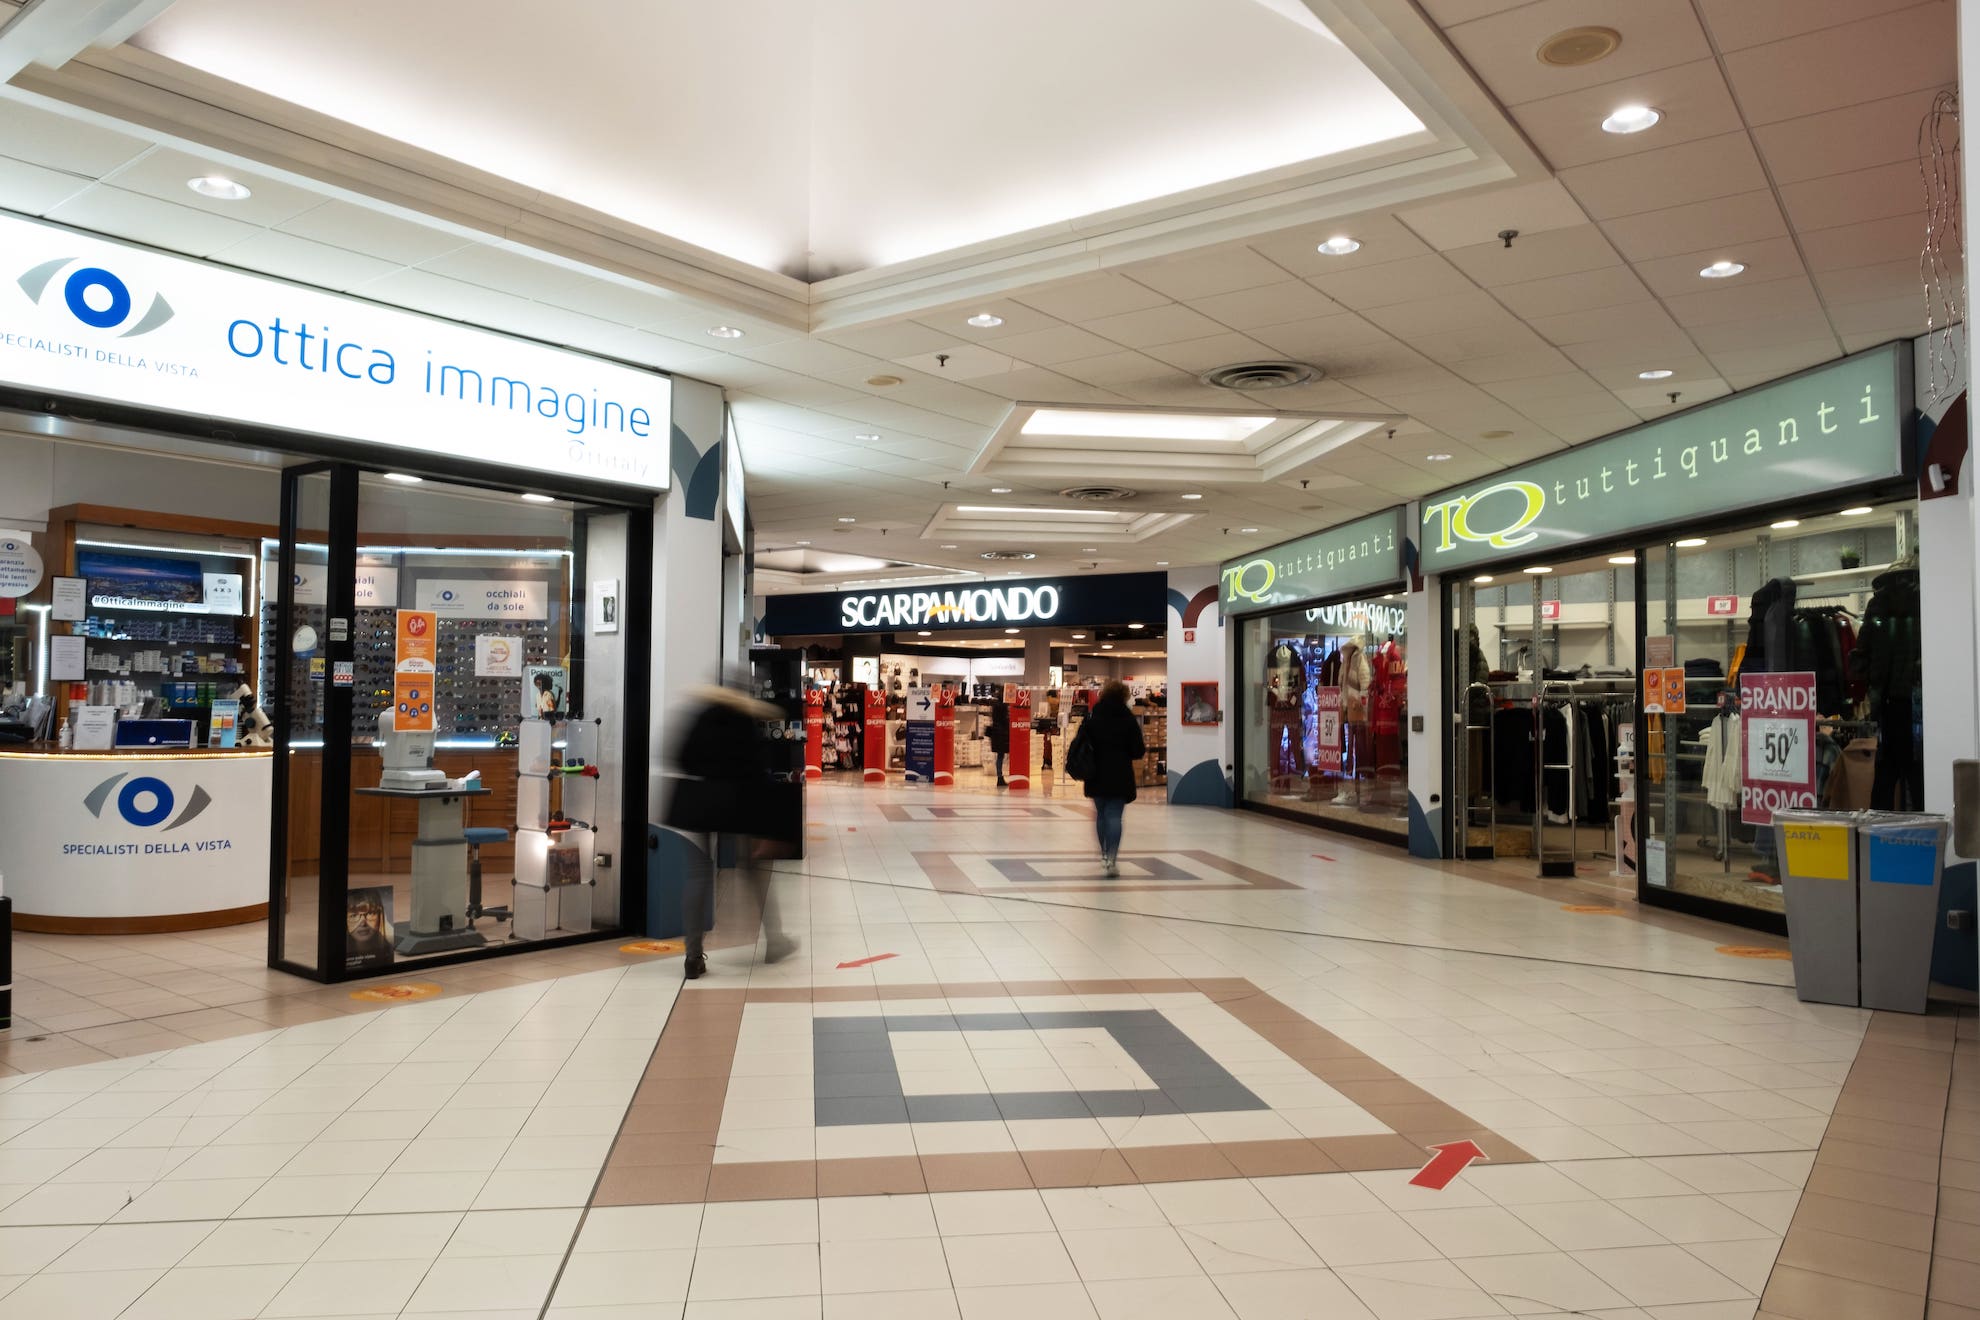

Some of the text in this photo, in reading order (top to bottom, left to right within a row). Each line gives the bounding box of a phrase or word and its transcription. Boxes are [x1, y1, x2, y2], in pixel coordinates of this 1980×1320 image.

[96, 350, 148, 369] DELLA
[155, 360, 200, 378] VISTA
[228, 317, 651, 437] ottica immagine
[1555, 384, 1880, 505] tuttiquanti
[1278, 528, 1394, 578] tuttiquanti
[0, 566, 36, 574] attamento
[486, 590, 526, 598] occhiali
[841, 584, 1059, 628] SCARPAMONDO
[488, 602, 524, 611] da sole
[531, 669, 562, 678] Polaroid
[1741, 686, 1816, 710] GRANDE
[1742, 786, 1816, 810] PROMO
[63, 840, 232, 855] SPECIALISTI DELLA VISTA
